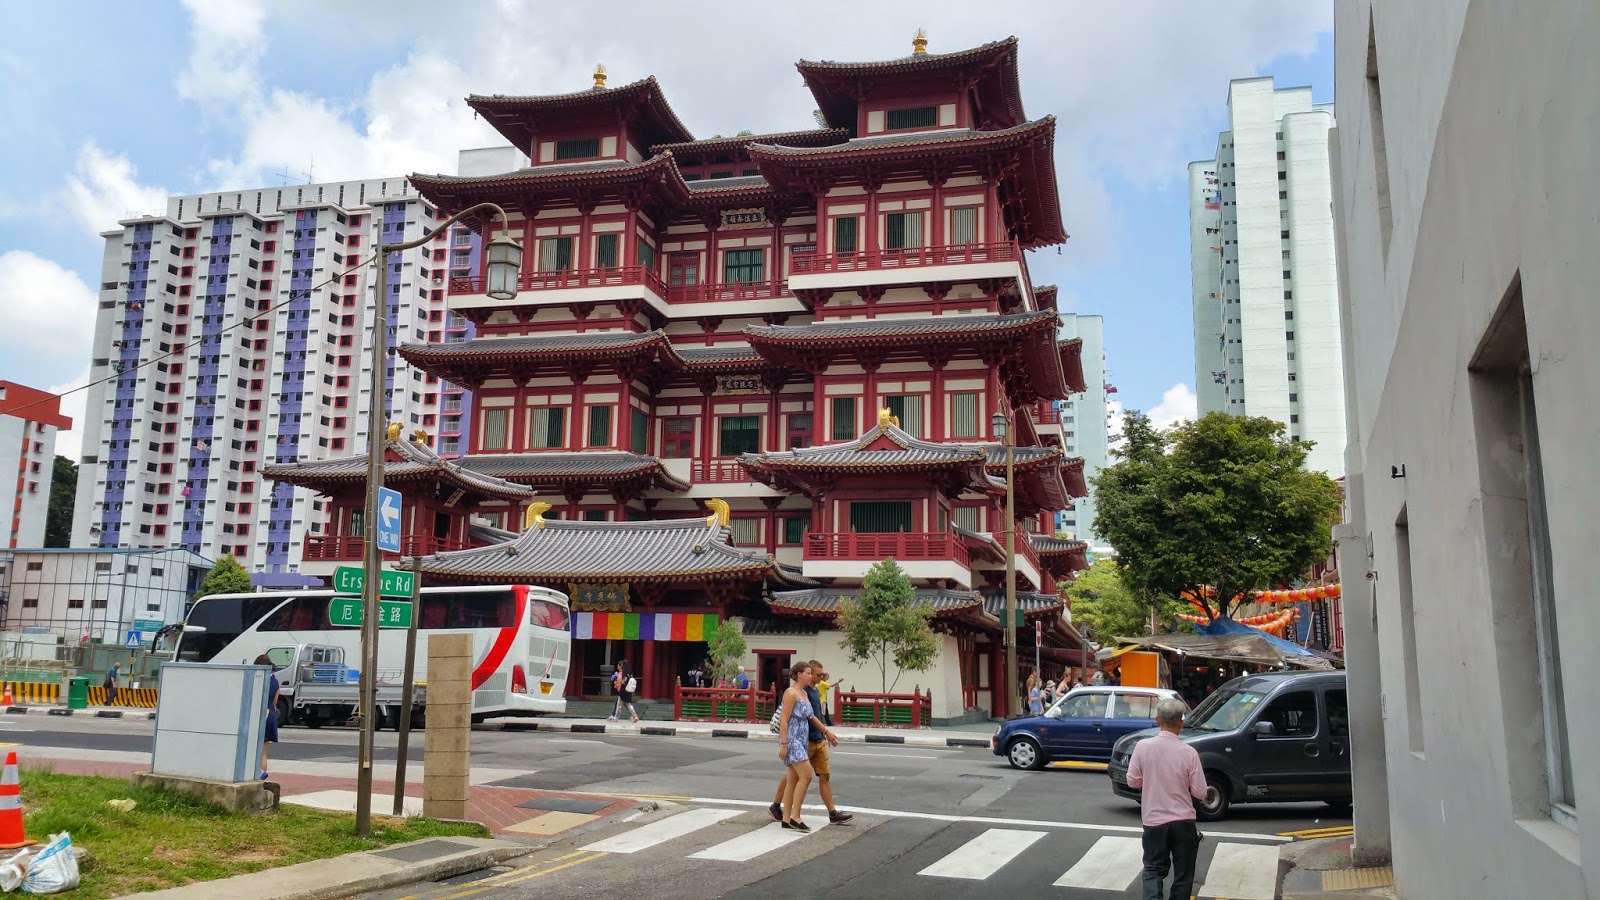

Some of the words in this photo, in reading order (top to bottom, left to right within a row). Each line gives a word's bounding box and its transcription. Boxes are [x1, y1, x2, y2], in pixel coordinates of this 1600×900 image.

[380, 530, 389, 543] ONE
[390, 533, 399, 546] WAY
[341, 571, 391, 591] Erse
[396, 577, 410, 592] Rd
[342, 605, 401, 623] 厄金路
